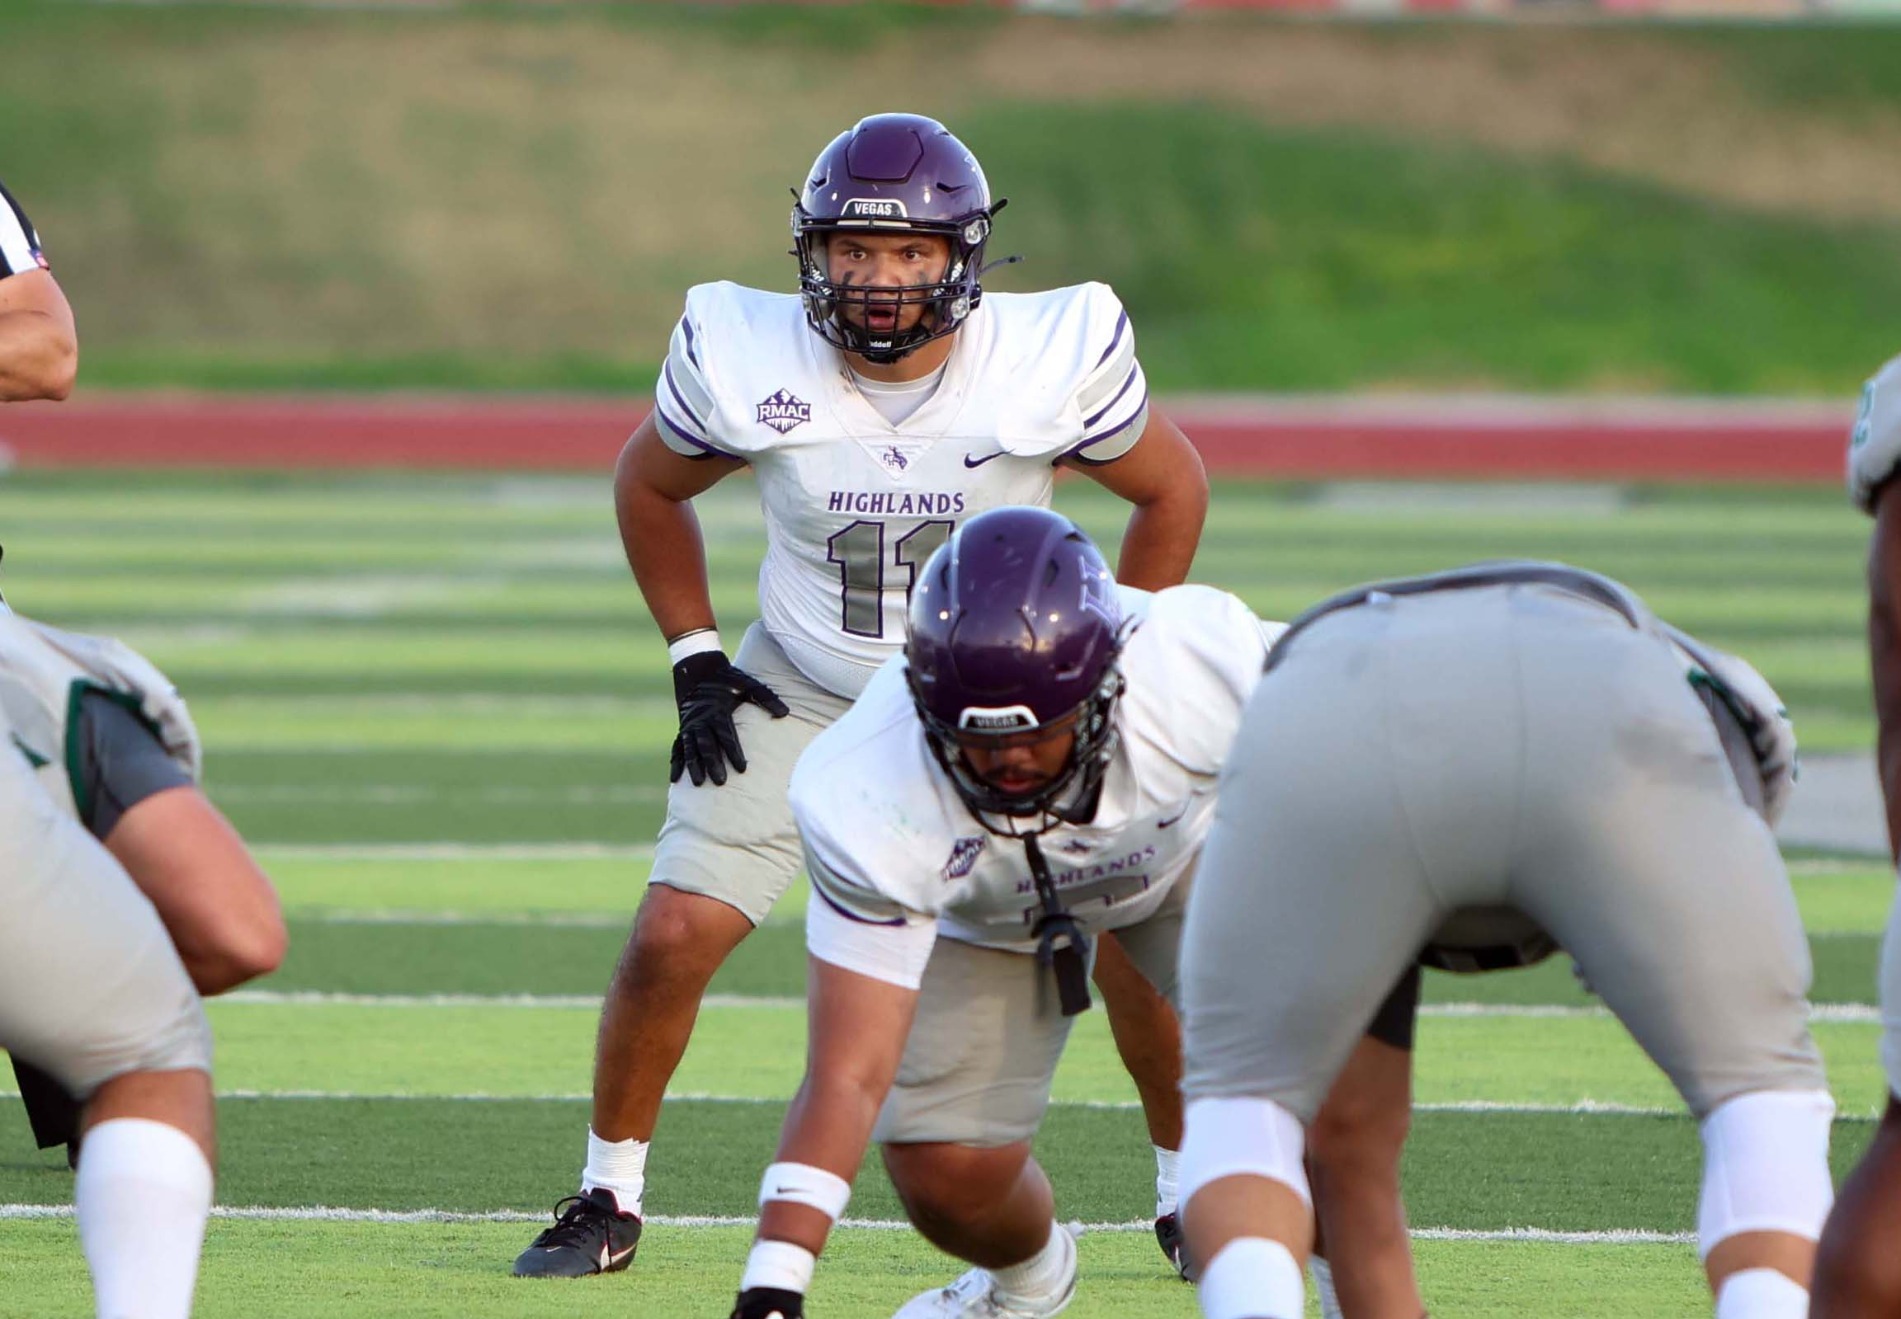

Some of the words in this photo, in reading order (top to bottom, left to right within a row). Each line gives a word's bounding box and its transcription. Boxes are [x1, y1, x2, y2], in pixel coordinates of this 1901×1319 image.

[854, 202, 892, 216] VEGAS
[759, 404, 809, 421] RMAC
[827, 491, 965, 515] HIGHLANDS
[1016, 845, 1156, 893] HHLANDS
